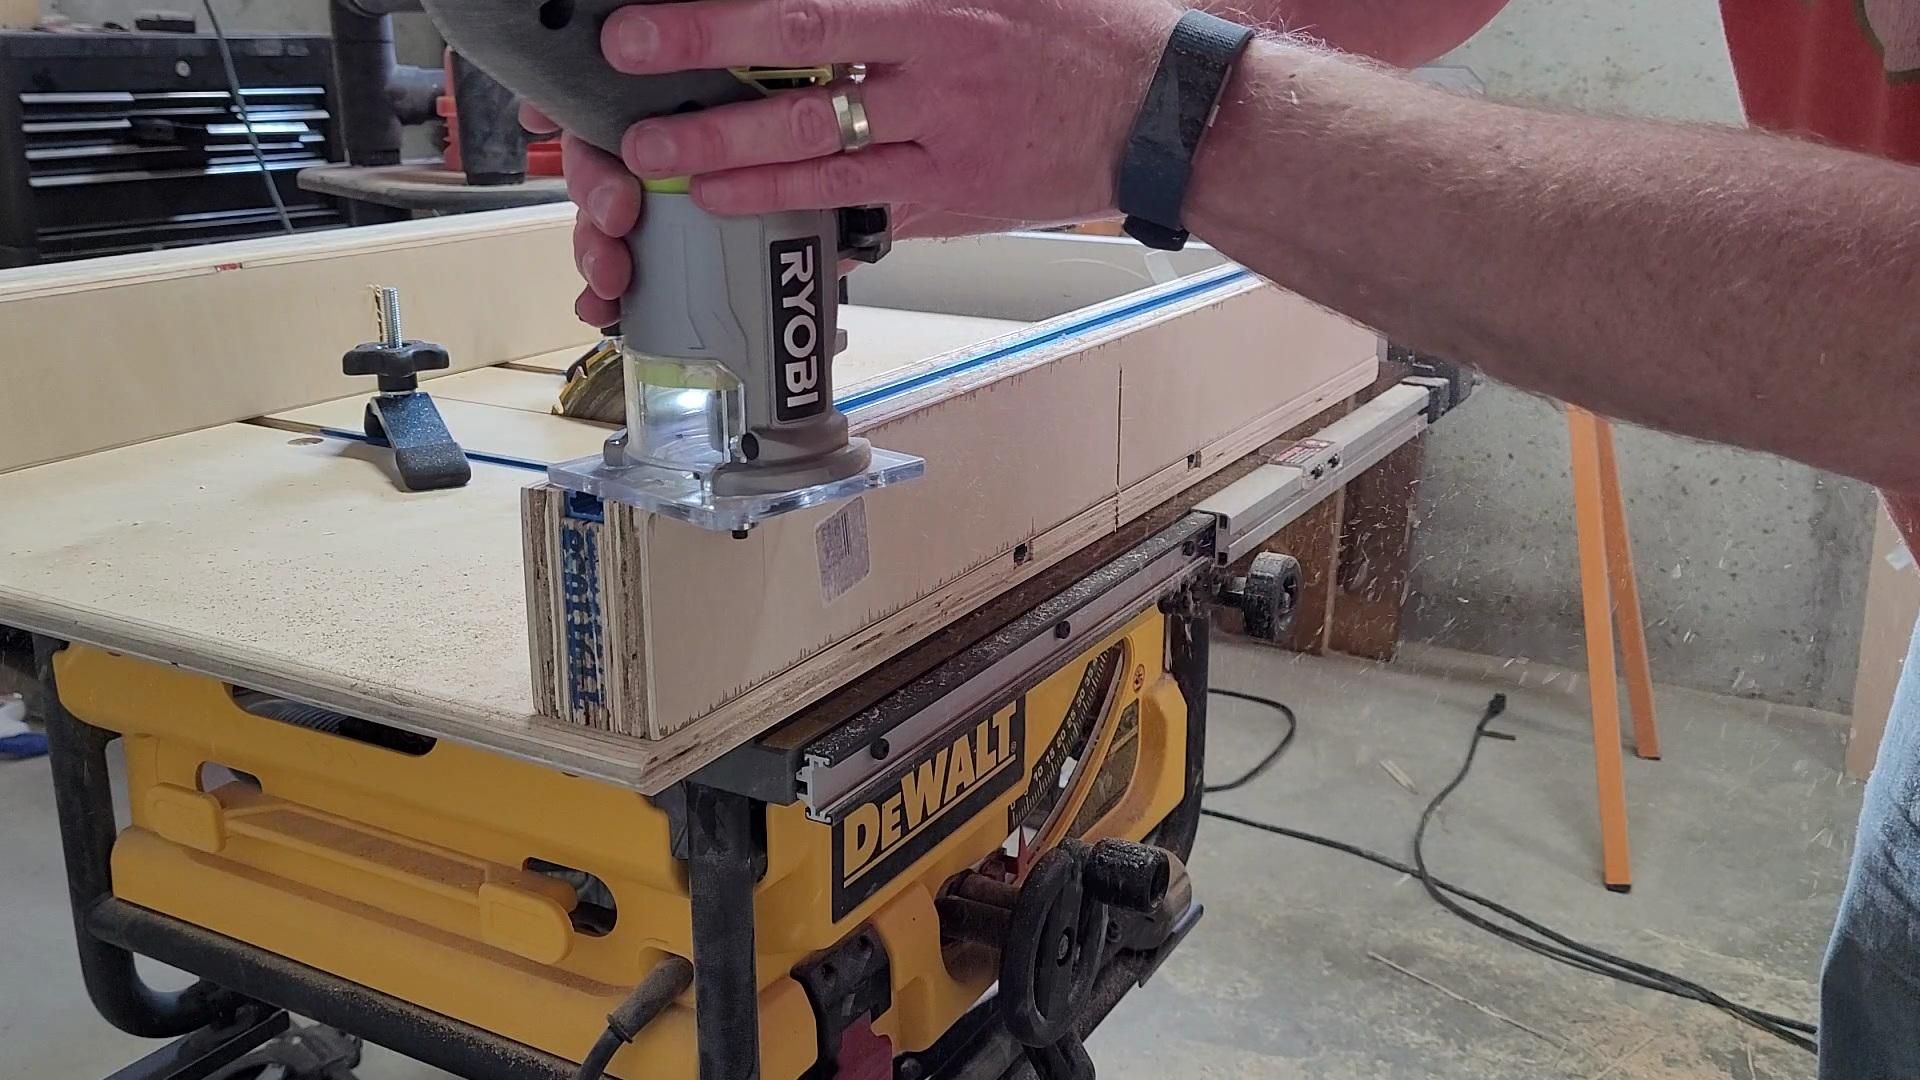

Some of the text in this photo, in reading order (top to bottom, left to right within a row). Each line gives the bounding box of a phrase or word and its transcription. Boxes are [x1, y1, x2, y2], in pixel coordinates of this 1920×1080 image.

[780, 245, 819, 408] RYOBI
[1077, 689, 1086, 708] 30
[1045, 749, 1056, 764] 15
[1033, 765, 1044, 782] 10
[843, 700, 1017, 878] DEWALT
